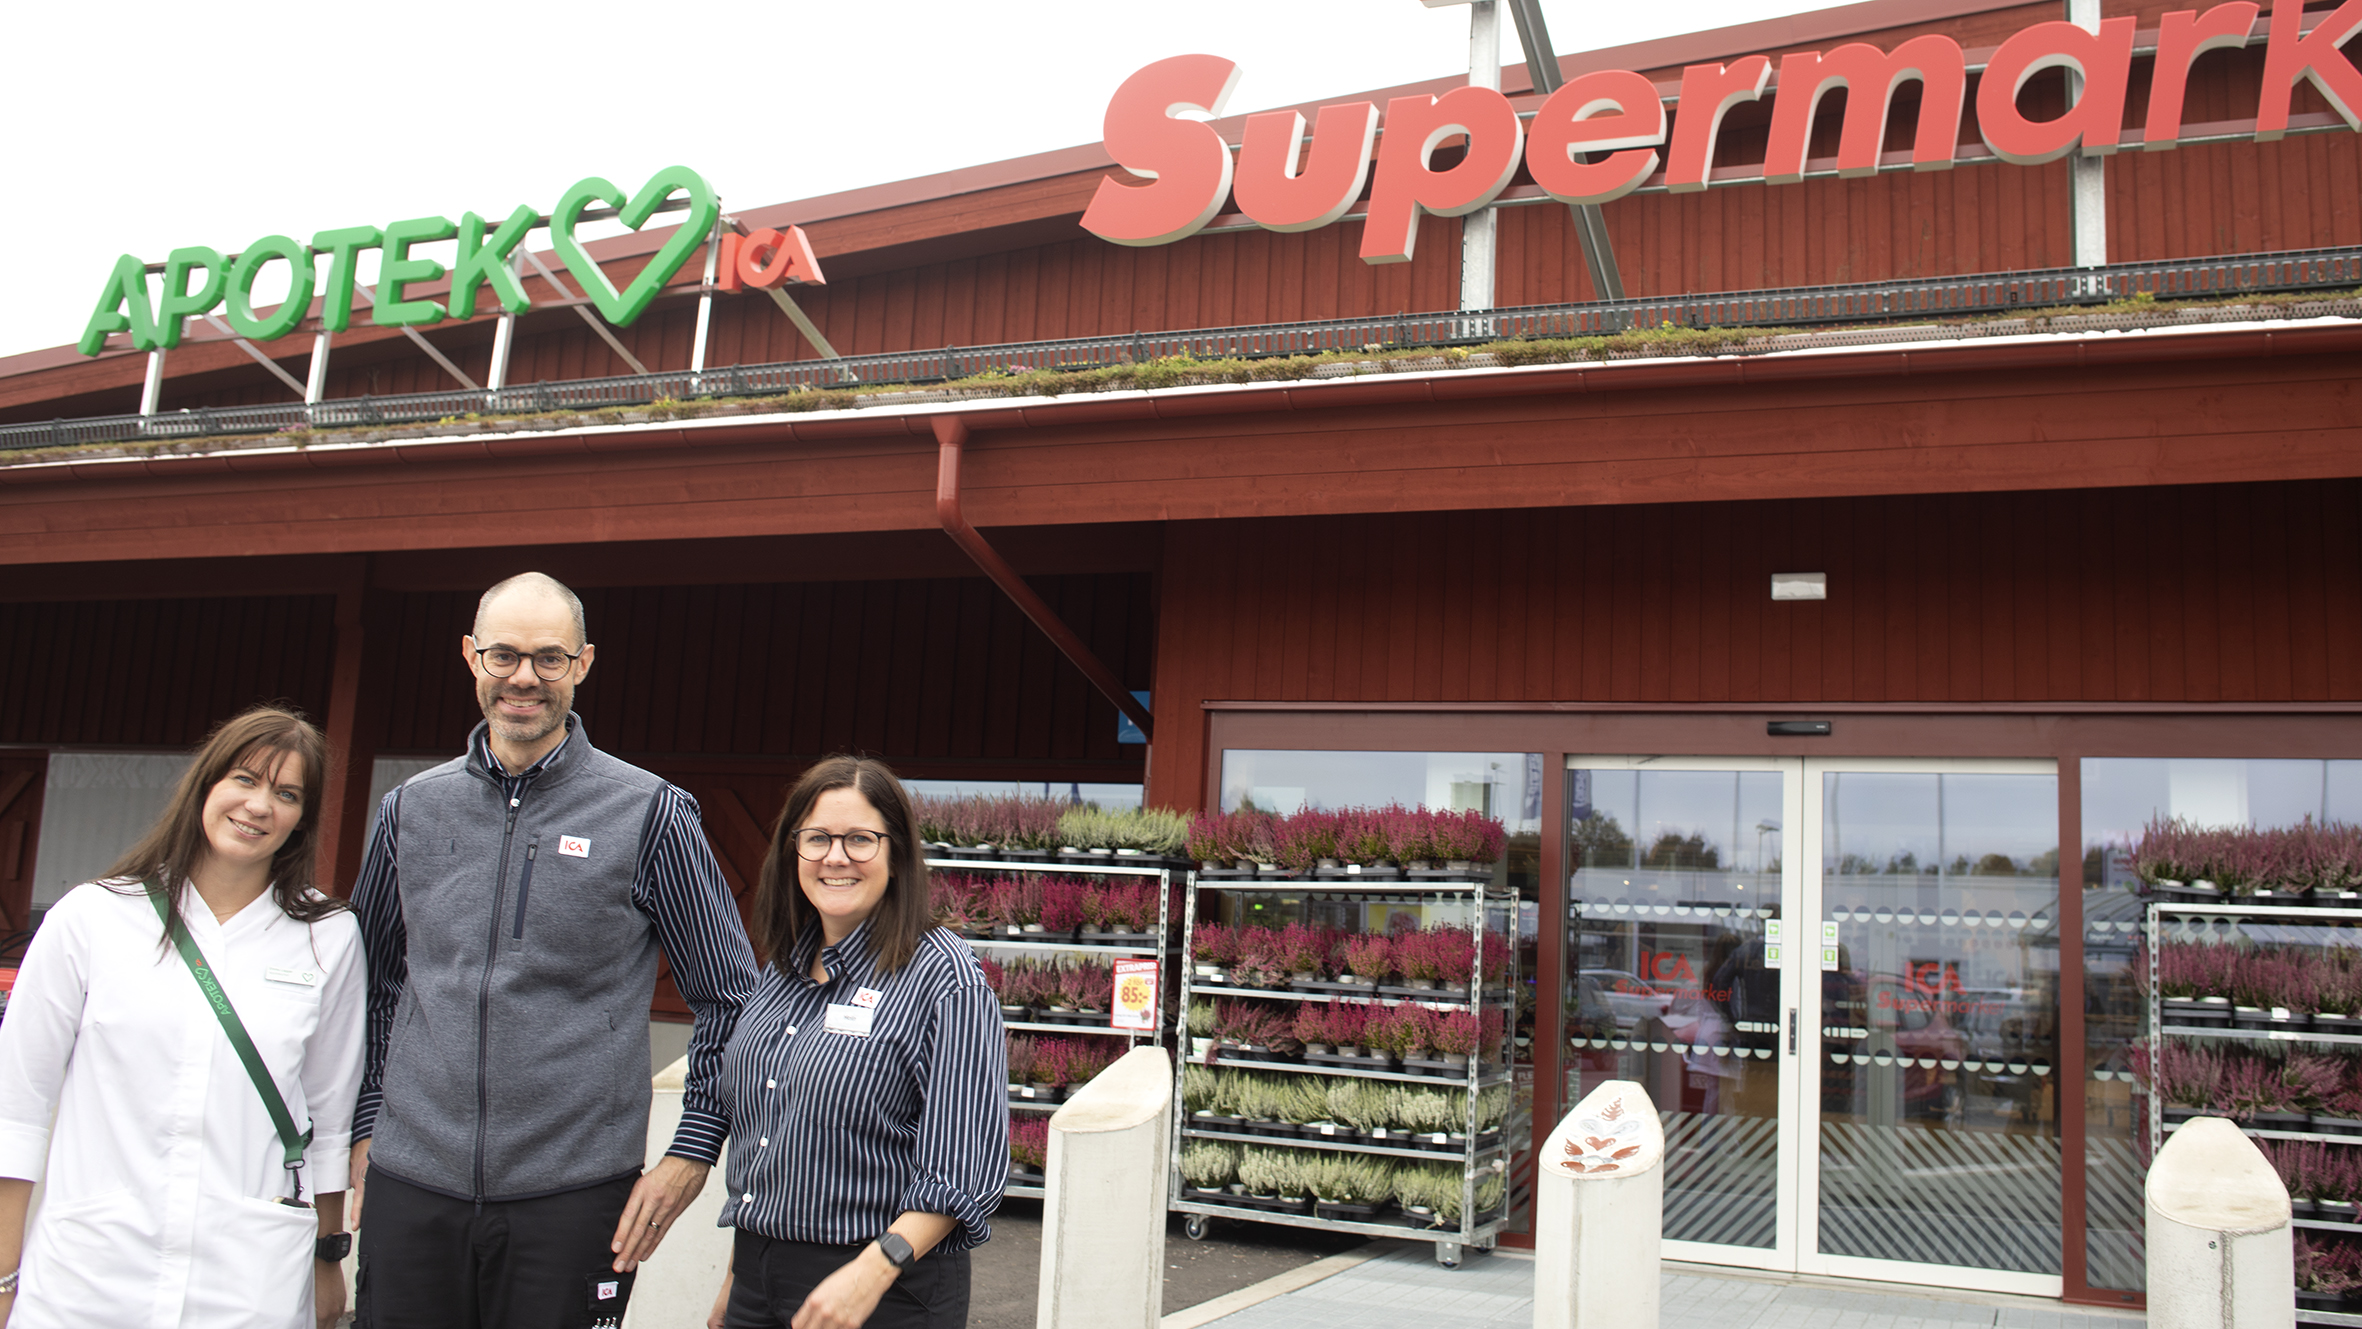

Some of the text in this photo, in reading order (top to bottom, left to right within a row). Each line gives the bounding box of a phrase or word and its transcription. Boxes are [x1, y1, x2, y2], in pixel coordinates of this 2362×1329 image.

[77, 204, 827, 357] APOTEK ICA
[564, 840, 583, 852] ICA
[1640, 951, 1699, 982] ICA
[1904, 961, 1968, 996] ICA
[202, 977, 232, 1015] APOTEK
[858, 992, 873, 1003] ICA
[1122, 986, 1148, 1003] 85:-
[1614, 978, 1734, 1003] Supermarket
[1876, 990, 2006, 1015] Supermarket
[602, 1288, 613, 1297] ICA
